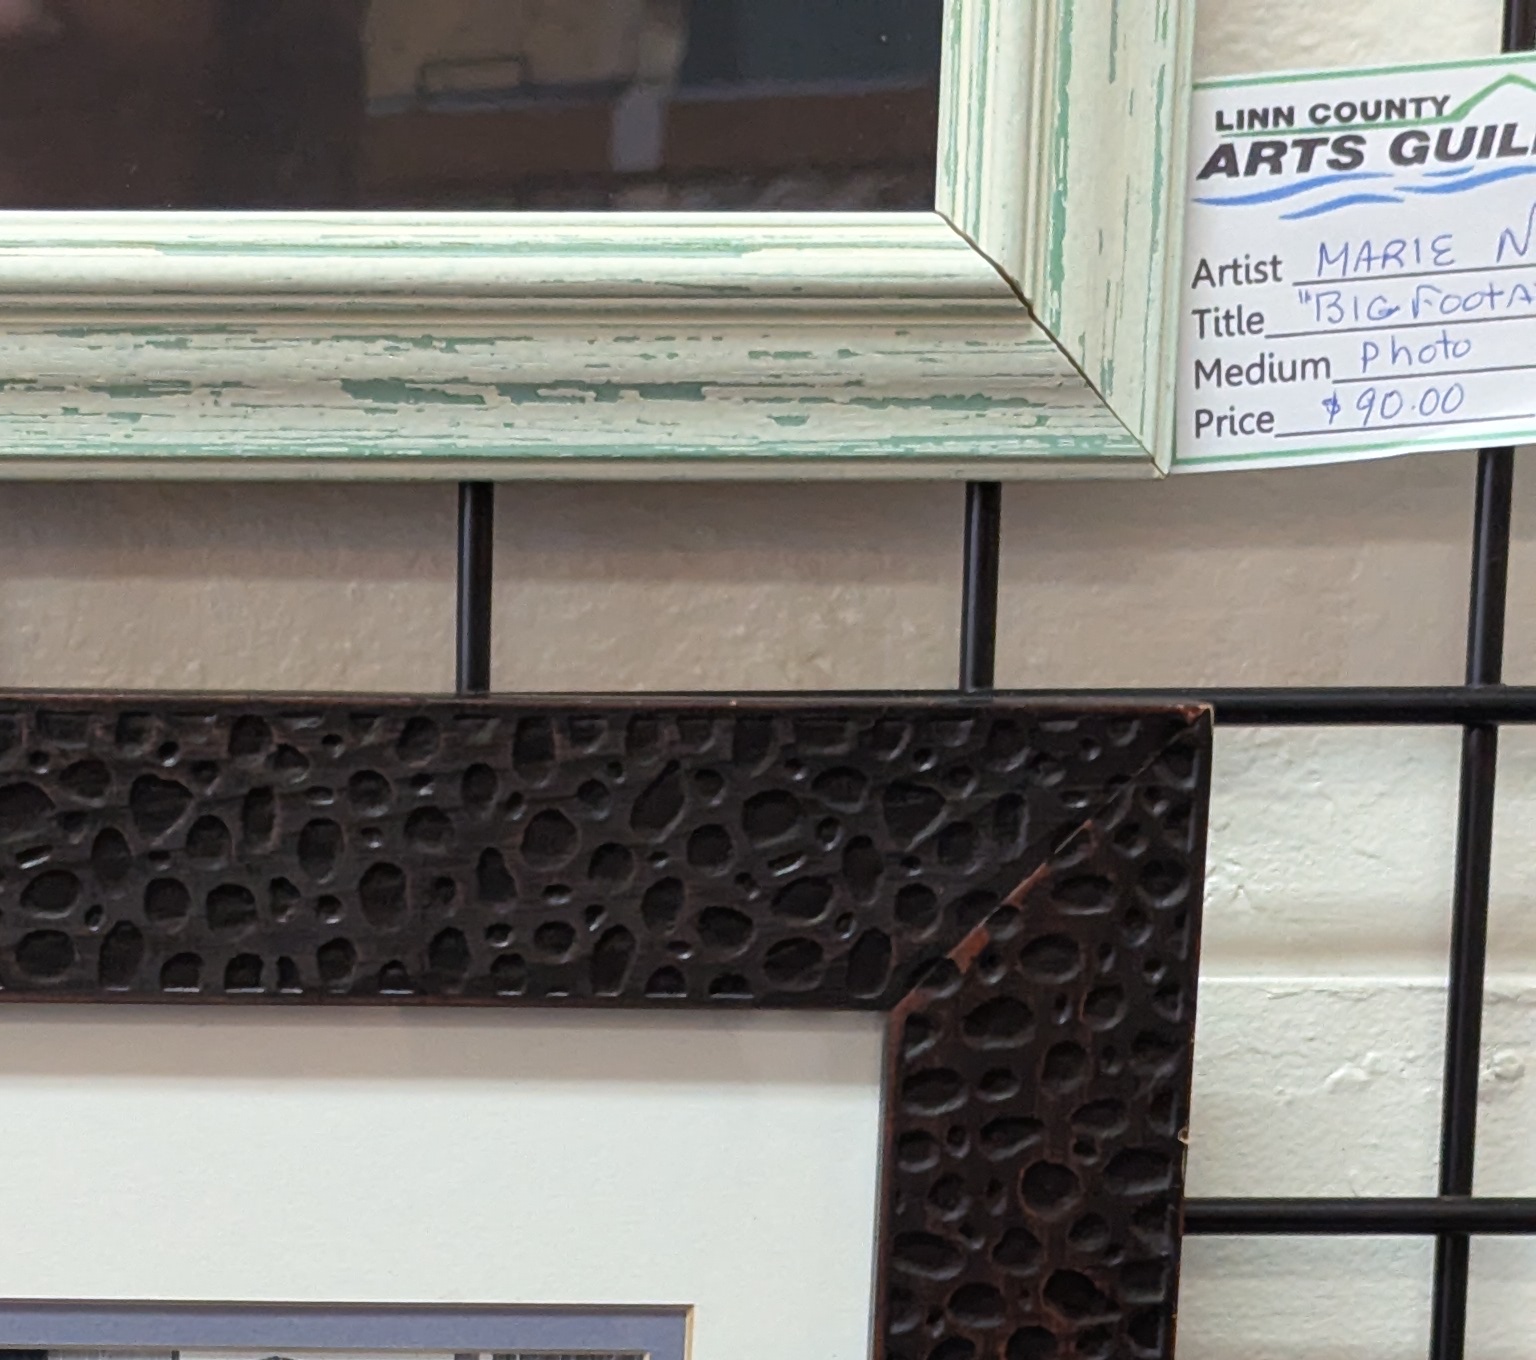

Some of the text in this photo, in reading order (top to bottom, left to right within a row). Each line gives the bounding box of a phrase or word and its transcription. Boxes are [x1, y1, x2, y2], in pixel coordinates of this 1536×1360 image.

[1216, 94, 1451, 132] LINN COUNTY
[1195, 122, 1536, 181] ARTS GUIL
[1191, 253, 1283, 290] Artist
[1316, 233, 1456, 278] MARIE
[1191, 303, 1265, 340] Title
[1194, 351, 1332, 390] Medium
[1194, 404, 1275, 440] Price
